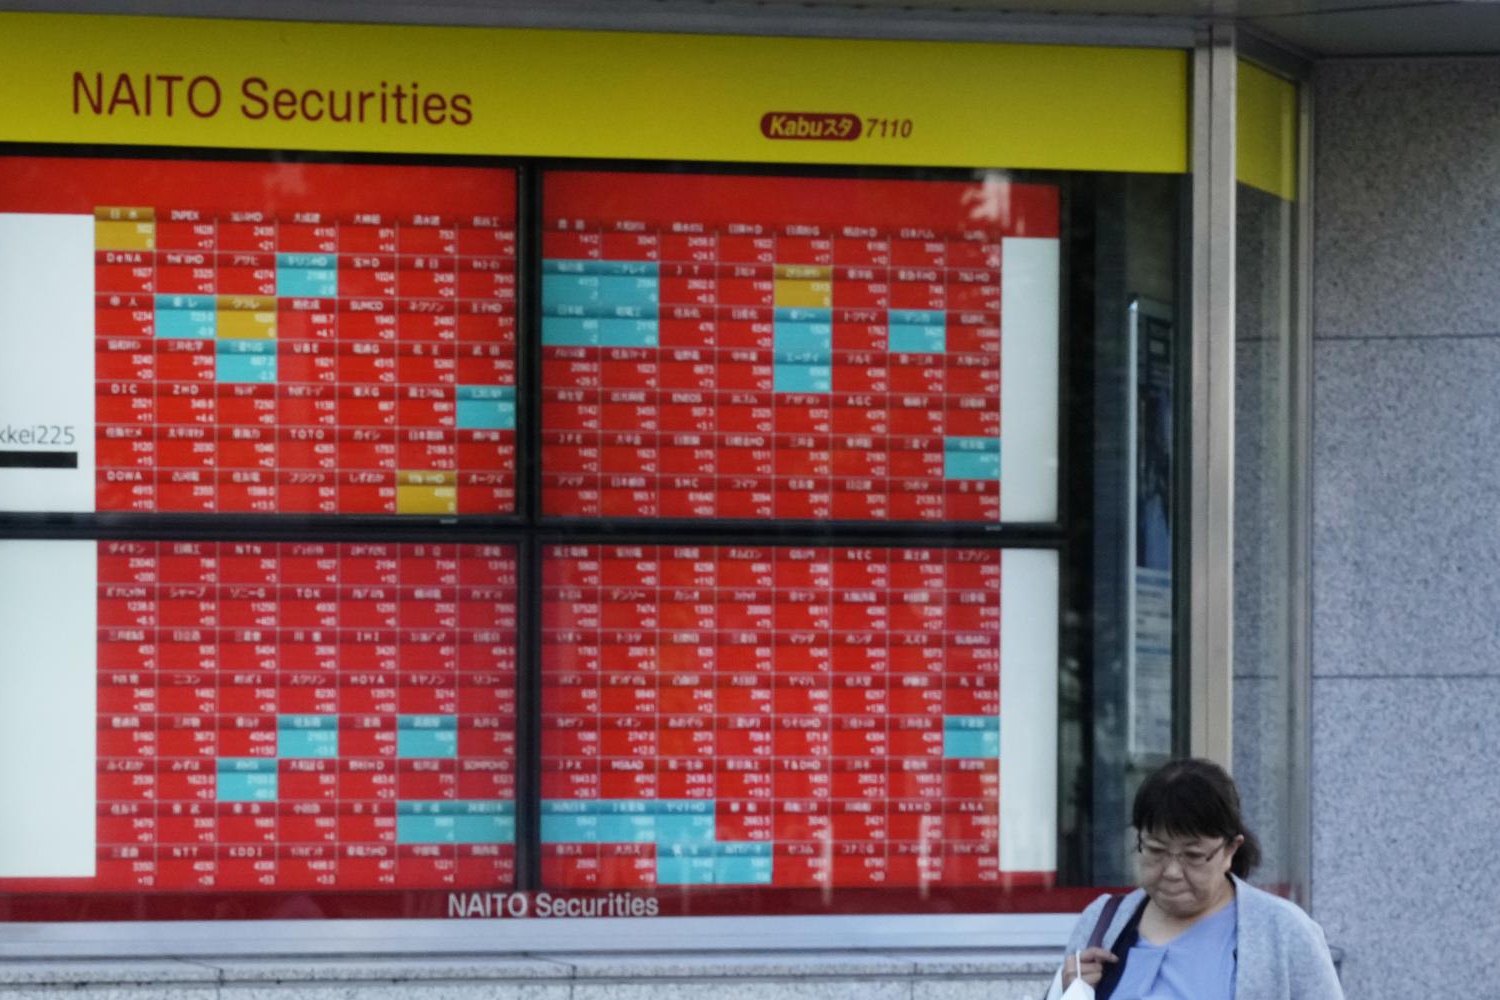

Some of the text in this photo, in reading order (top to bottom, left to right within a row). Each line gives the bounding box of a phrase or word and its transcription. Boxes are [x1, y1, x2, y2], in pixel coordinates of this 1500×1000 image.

[73, 71, 473, 126] NAITO Securities
[769, 114, 914, 140] Kabuスタ 7110
[448, 892, 660, 918] NAITO Securities
